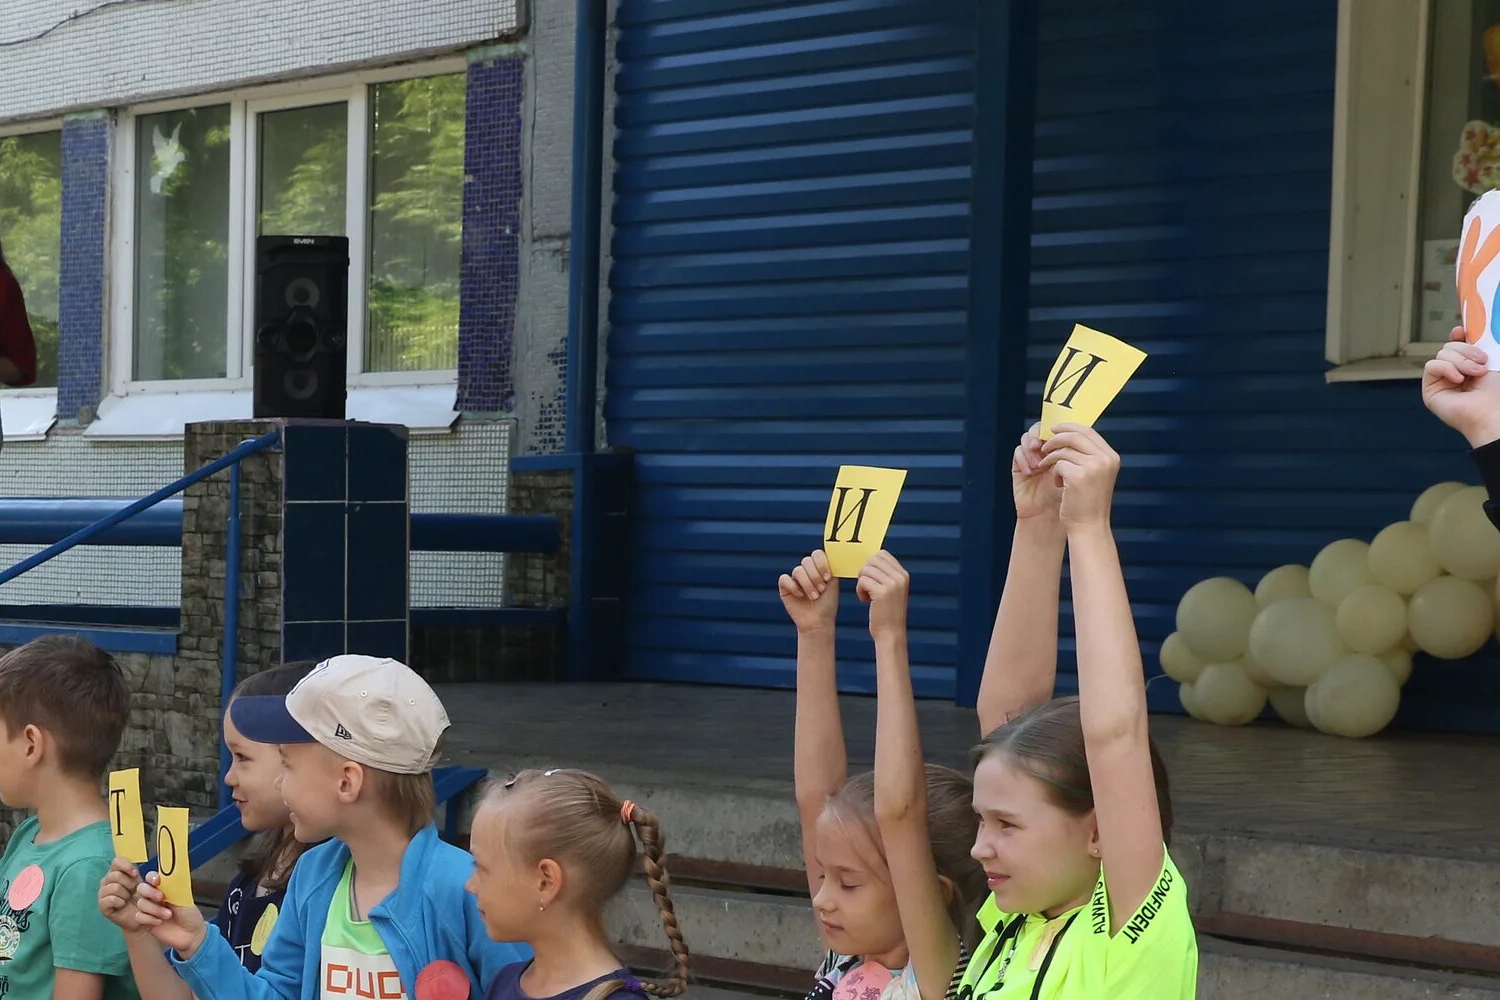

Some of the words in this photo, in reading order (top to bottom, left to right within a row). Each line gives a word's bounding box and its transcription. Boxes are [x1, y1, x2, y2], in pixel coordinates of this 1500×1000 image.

[1043, 346, 1108, 409] И
[825, 486, 879, 544] И
[110, 789, 126, 837] Т
[1122, 869, 1173, 945] CONFIDENT
